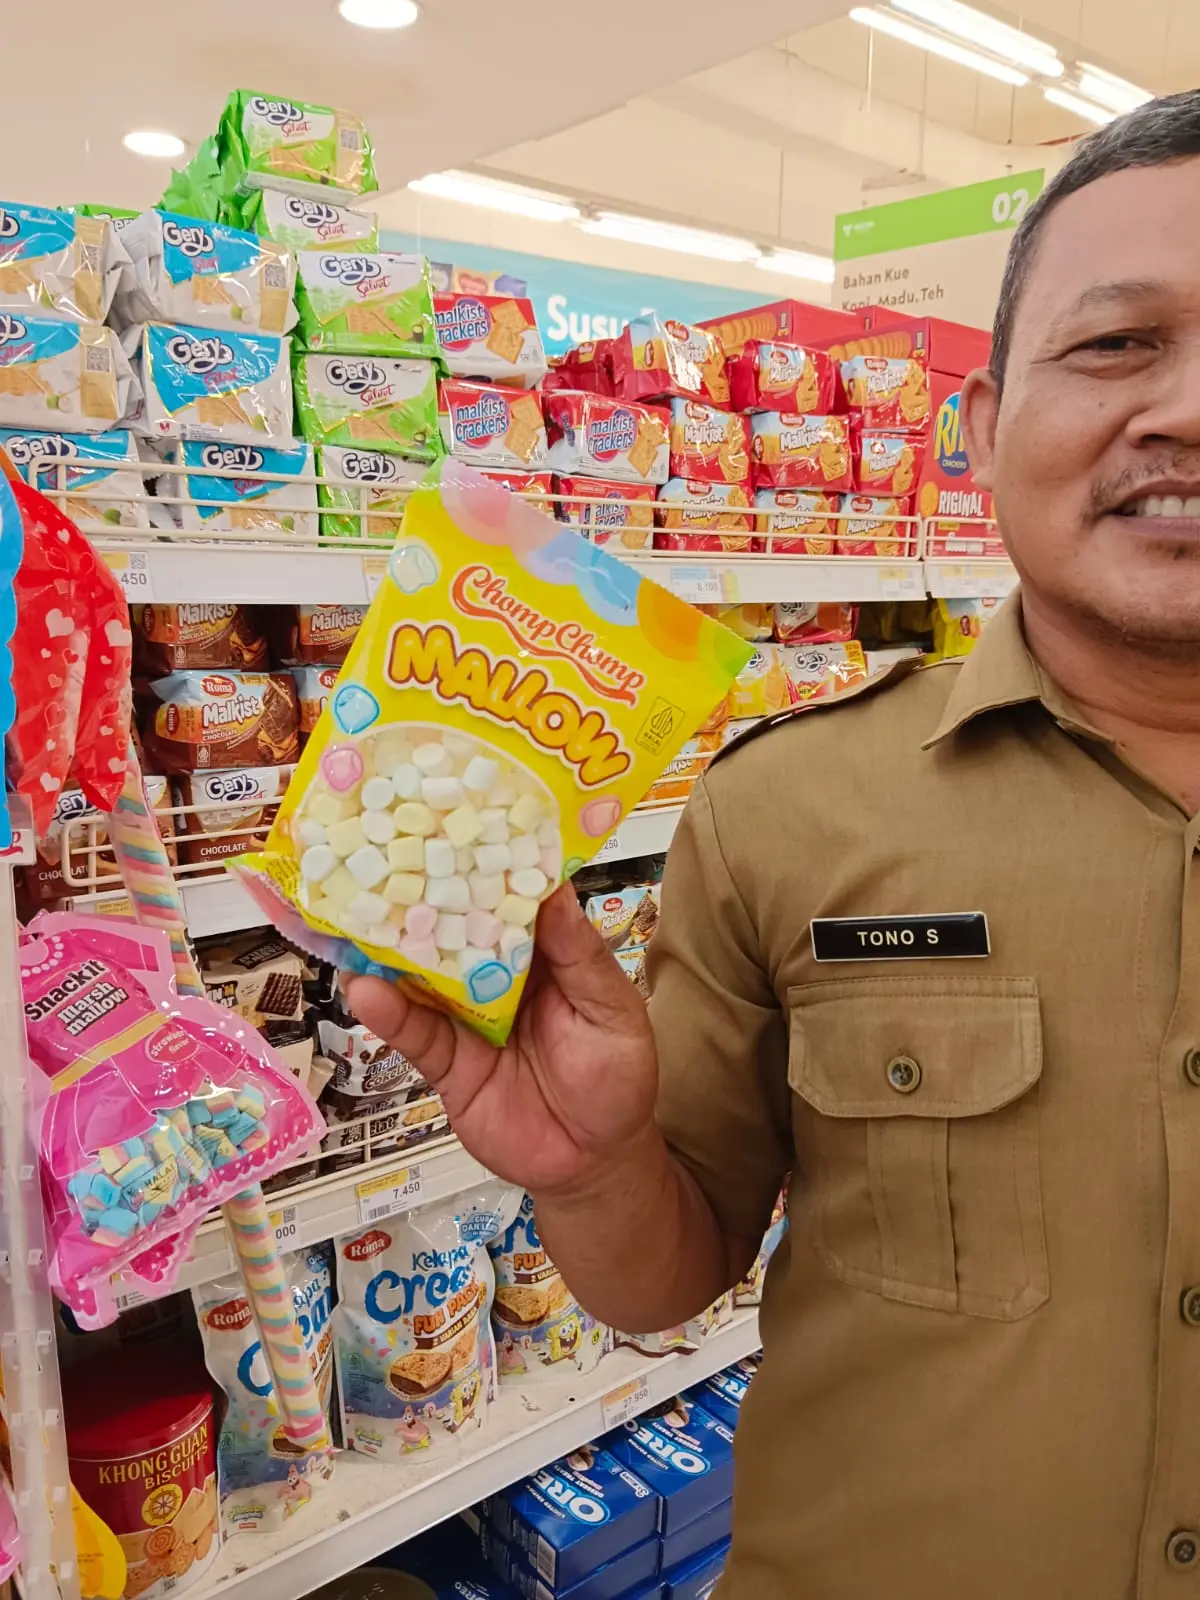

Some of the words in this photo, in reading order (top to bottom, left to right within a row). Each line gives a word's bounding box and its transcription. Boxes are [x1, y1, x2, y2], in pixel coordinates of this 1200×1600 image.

[250, 96, 303, 125] Gery
[285, 196, 339, 228] Gery
[163, 220, 214, 257] Gery
[320, 255, 381, 285] Gery
[843, 272, 881, 289] Bahan
[884, 268, 910, 282] Kue
[435, 304, 485, 325] malkist
[435, 320, 487, 343] rackers
[167, 335, 234, 375] Gery
[326, 359, 386, 395] Gery
[456, 399, 506, 421] malkist
[590, 414, 634, 434] malkist
[202, 443, 265, 478] Gery
[342, 451, 396, 482] Gery
[312, 607, 361, 632] Malkist
[202, 694, 260, 728] Malkist
[388, 623, 632, 787] MALLOW
[205, 774, 259, 802] Gery
[201, 843, 248, 856] CHOCOLATE
[857, 930, 914, 946] TONO
[927, 928, 940, 944] S
[24, 959, 108, 1021] Snackit
[56, 982, 114, 1024] marsh
[65, 988, 129, 1037] mallow
[393, 1181, 420, 1199] 7.450
[351, 1237, 386, 1257] Roma
[514, 1252, 546, 1271] FUN
[414, 1305, 446, 1337] FUN
[99, 1451, 168, 1485] KHONG
[170, 1421, 208, 1465] GUAN
[145, 1441, 208, 1490] BISCUITS
